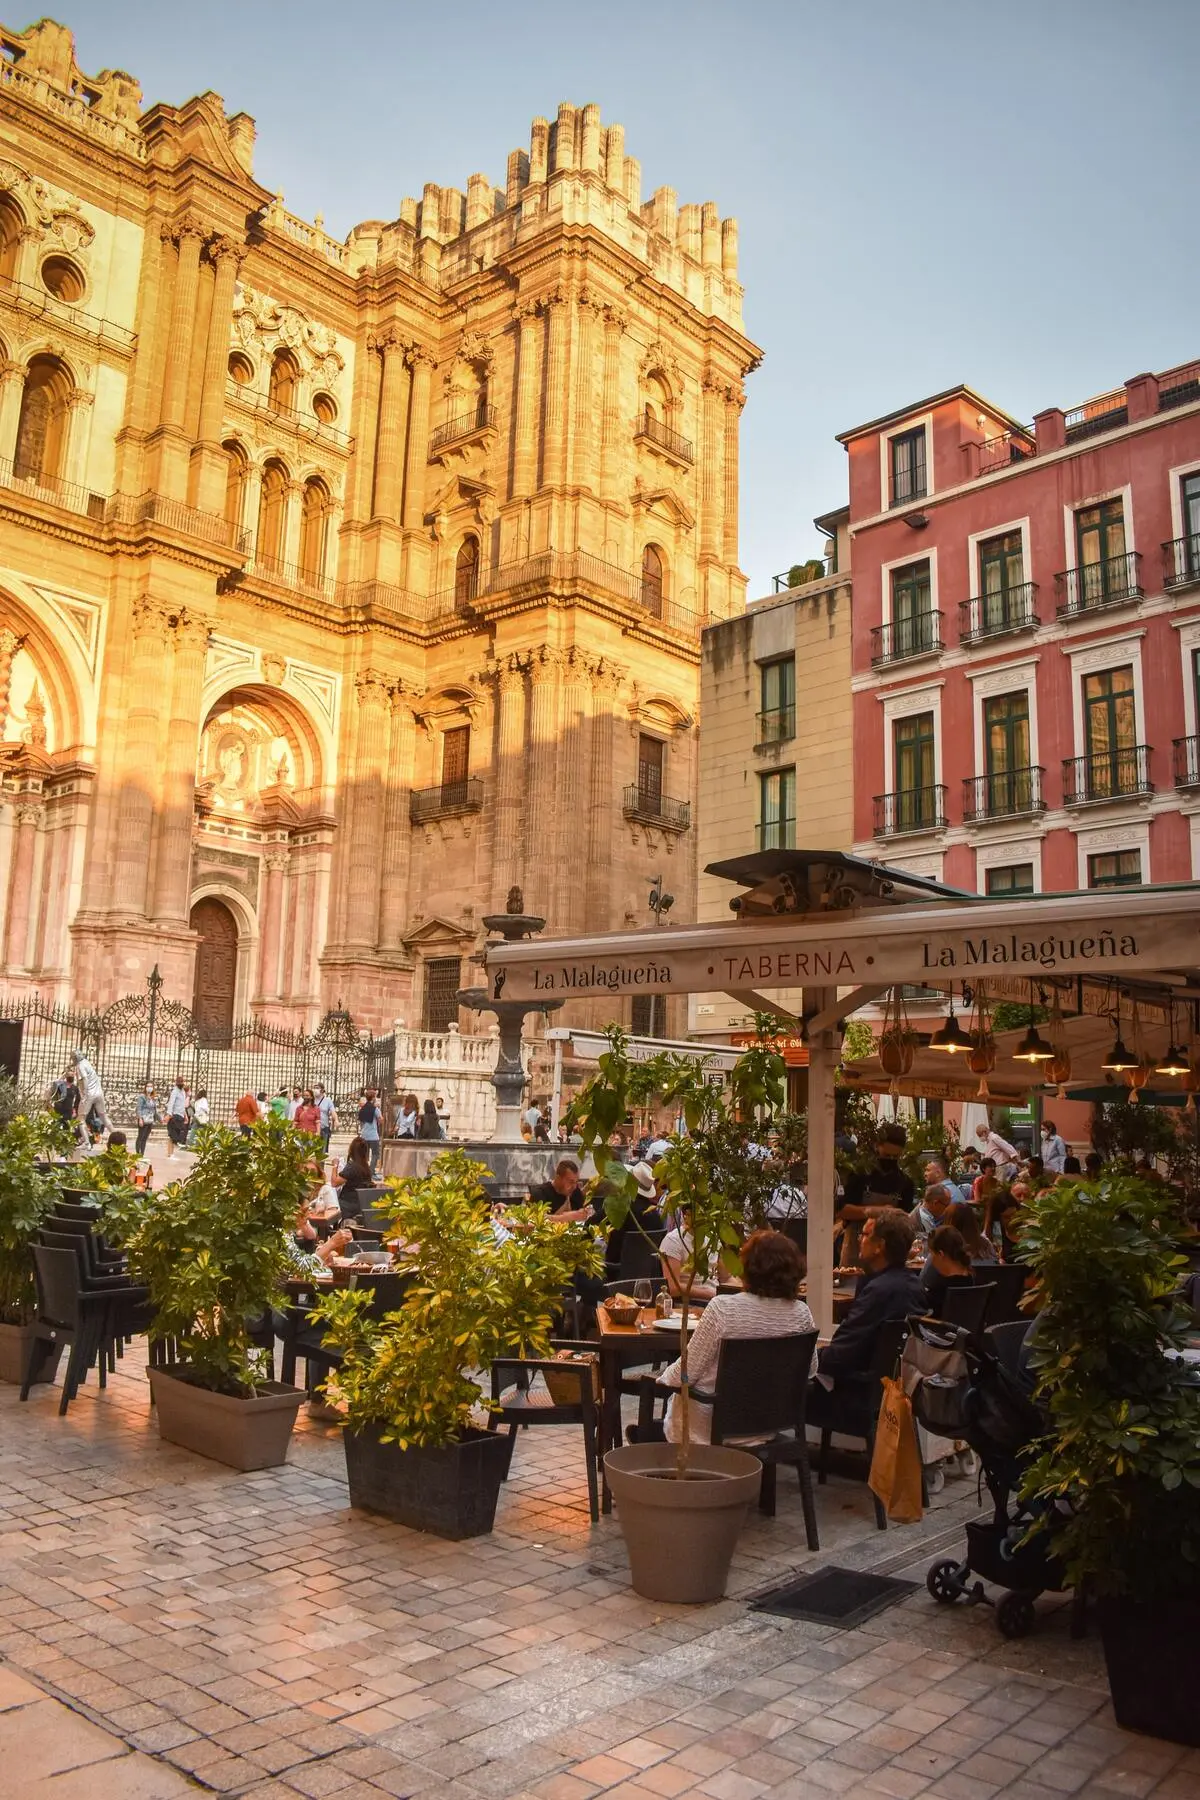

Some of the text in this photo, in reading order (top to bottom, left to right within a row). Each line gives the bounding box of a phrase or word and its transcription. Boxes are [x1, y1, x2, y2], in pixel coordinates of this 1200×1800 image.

[534, 929, 1139, 991] La Malagueña TABERNA La Malagueña
